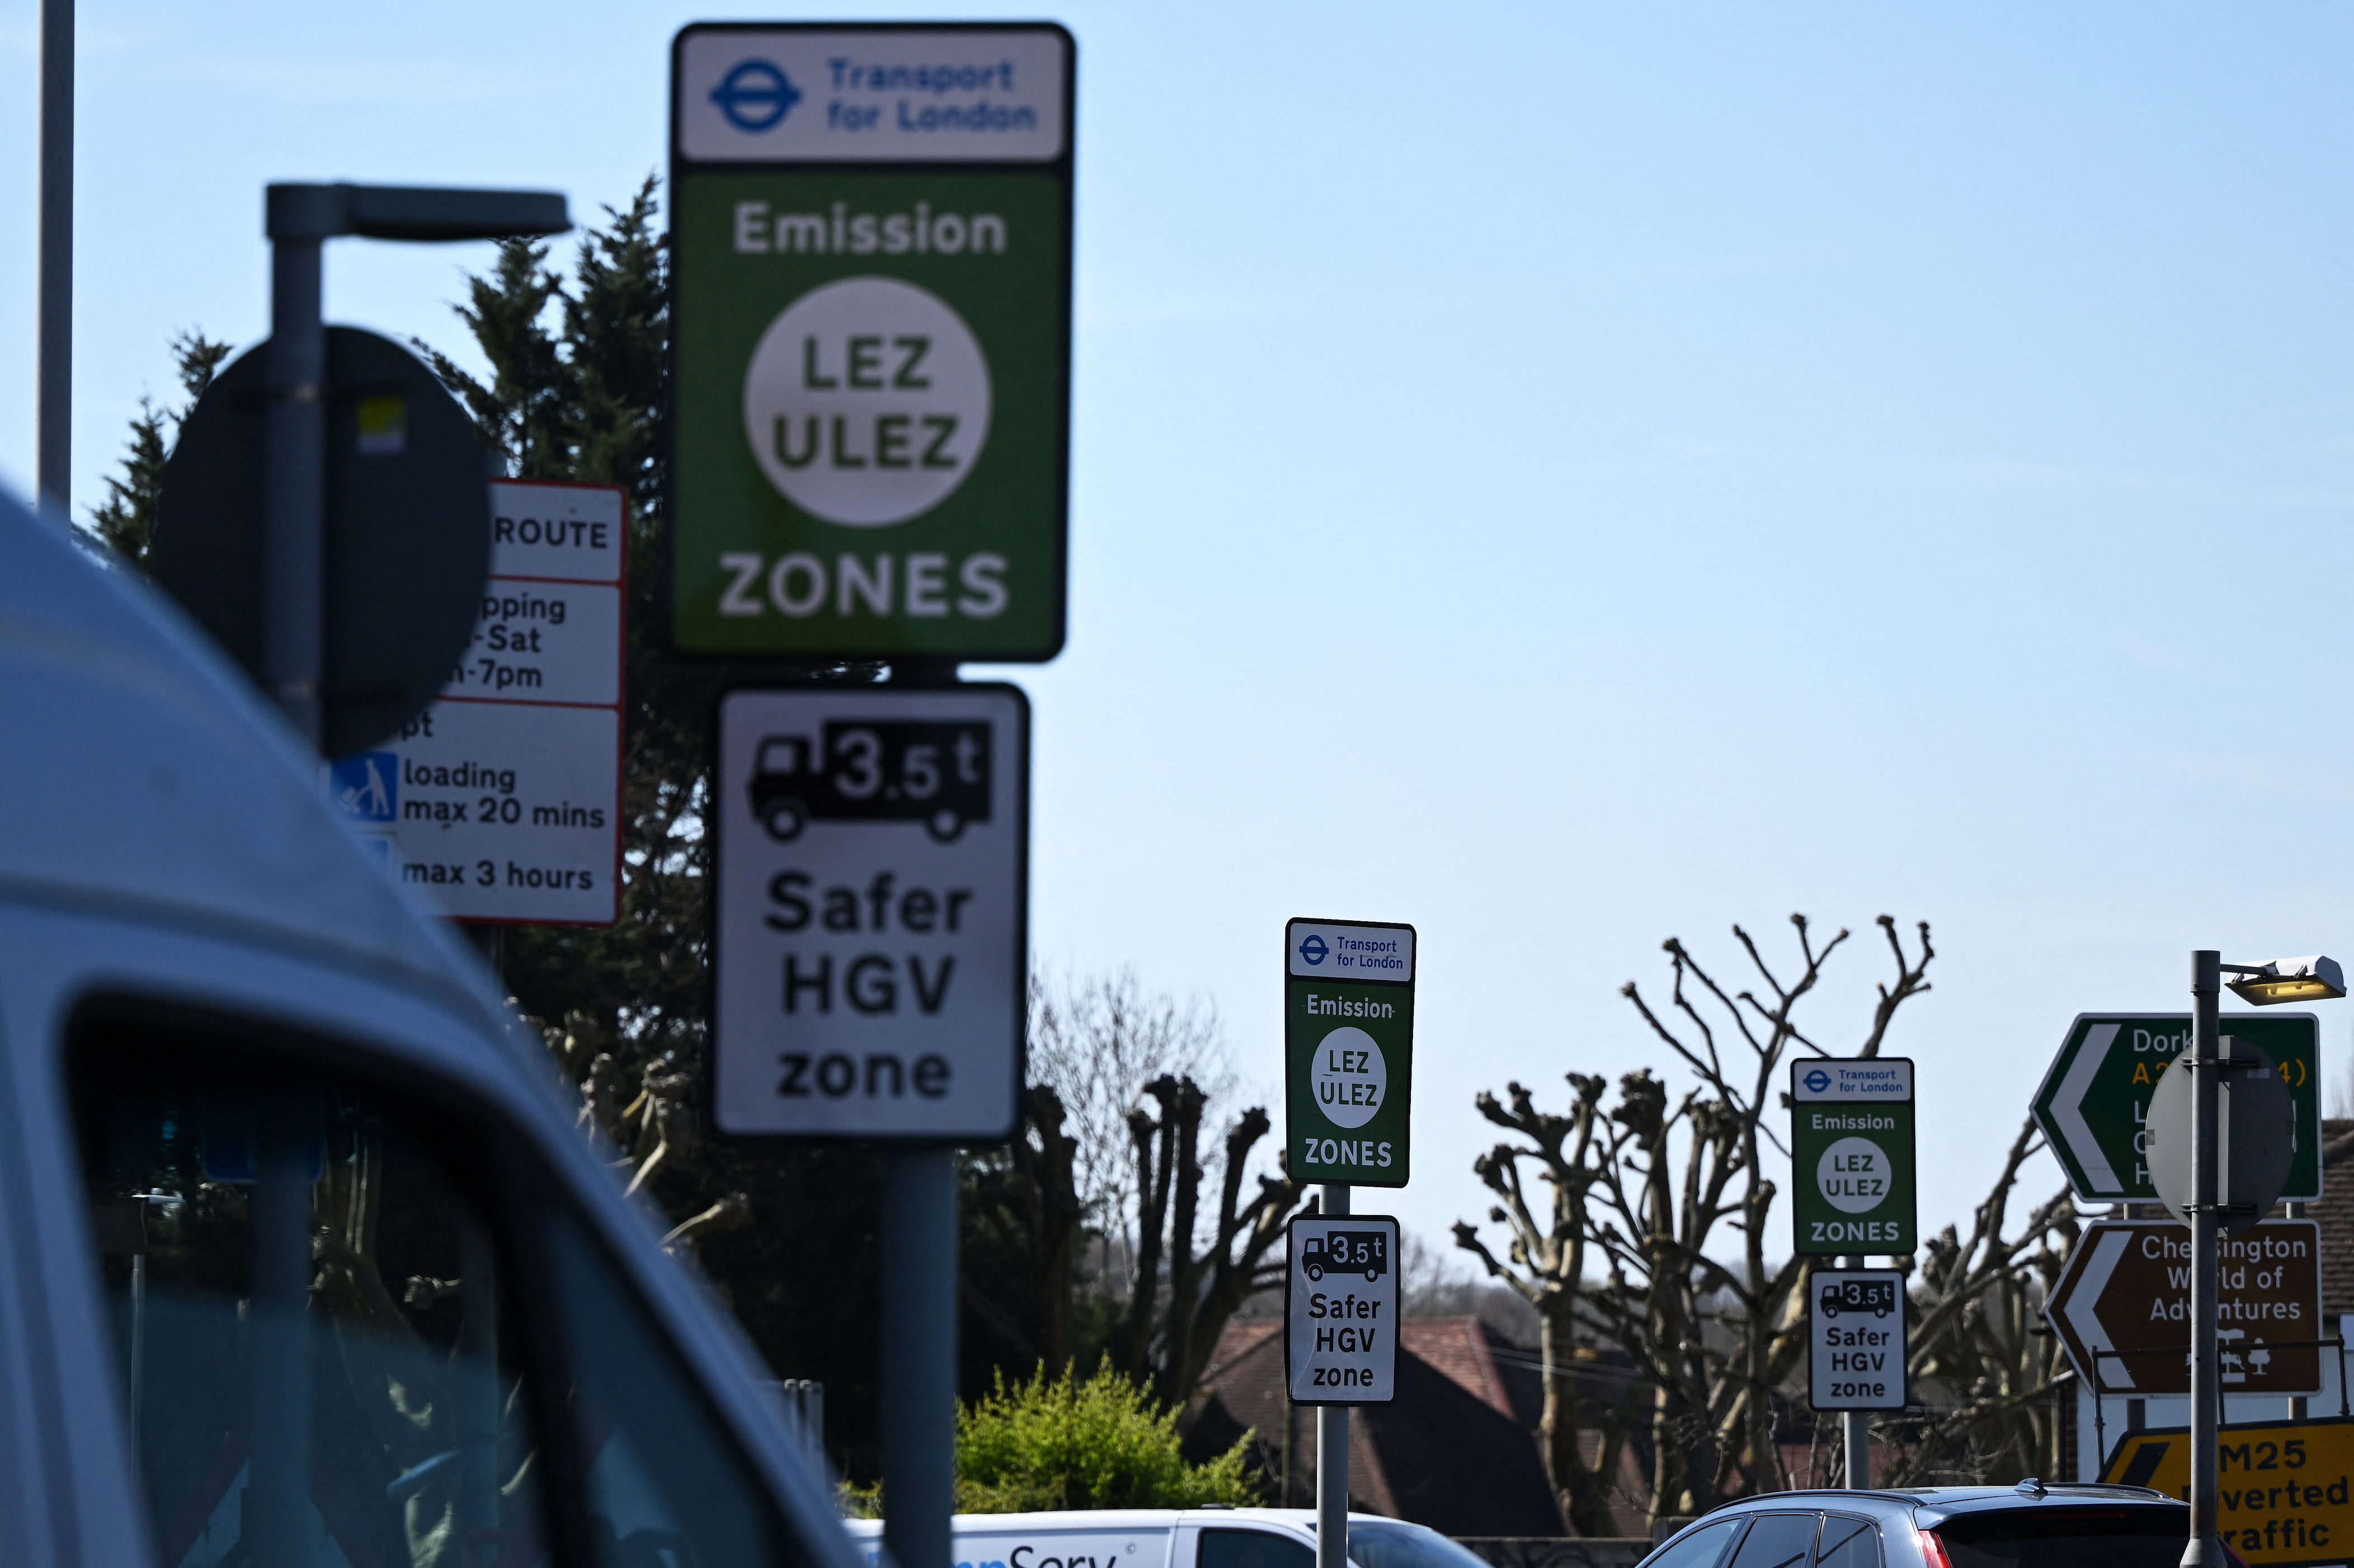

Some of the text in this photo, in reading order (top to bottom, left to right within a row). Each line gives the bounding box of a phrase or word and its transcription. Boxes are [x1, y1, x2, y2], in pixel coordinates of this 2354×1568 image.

[827, 58, 1013, 94] Transport
[827, 99, 1037, 131] for London
[735, 203, 1005, 253] Emission
[803, 336, 930, 391] LEZ
[773, 413, 959, 472] ULEZ
[495, 517, 607, 549] ROUTE
[721, 553, 1007, 617] ZONES
[482, 592, 566, 624] pping
[404, 759, 515, 794] loading
[404, 793, 605, 828] max 20 mins
[404, 860, 593, 890] max 3 hours
[763, 869, 972, 934] Safer
[1338, 936, 1396, 953] Transport
[1338, 953, 1402, 969] for London
[782, 953, 955, 1016] HGV
[1307, 994, 1392, 1019] Emission
[2133, 1029, 2193, 1052] Dork
[1330, 1050, 1368, 1073] LEZ
[776, 1052, 950, 1099] zone
[1839, 1070, 1895, 1081] Transport
[1840, 1082, 1902, 1092] for London
[1321, 1081, 1377, 1106] ULEZ
[1812, 1114, 1894, 1129] Emission
[1306, 1138, 1391, 1166] ZONES
[1835, 1155, 1873, 1172] LEZ
[1826, 1179, 1882, 1196] ULEZ
[1811, 1222, 1898, 1241] ZONES
[2142, 1235, 2306, 1263] Cheington
[2167, 1265, 2284, 1289] Wld of
[1308, 1293, 1381, 1319] Safer
[2150, 1297, 2301, 1321] Adntures
[1317, 1327, 1375, 1352] HGV
[1826, 1327, 1889, 1346] Safer
[1832, 1352, 1884, 1371] HGV
[1313, 1368, 1373, 1386] zone
[1831, 1383, 1885, 1397] zone
[2219, 1439, 2306, 1472] M25
[2182, 1475, 2349, 1512] verted
[2218, 1518, 2329, 1551] raffic
